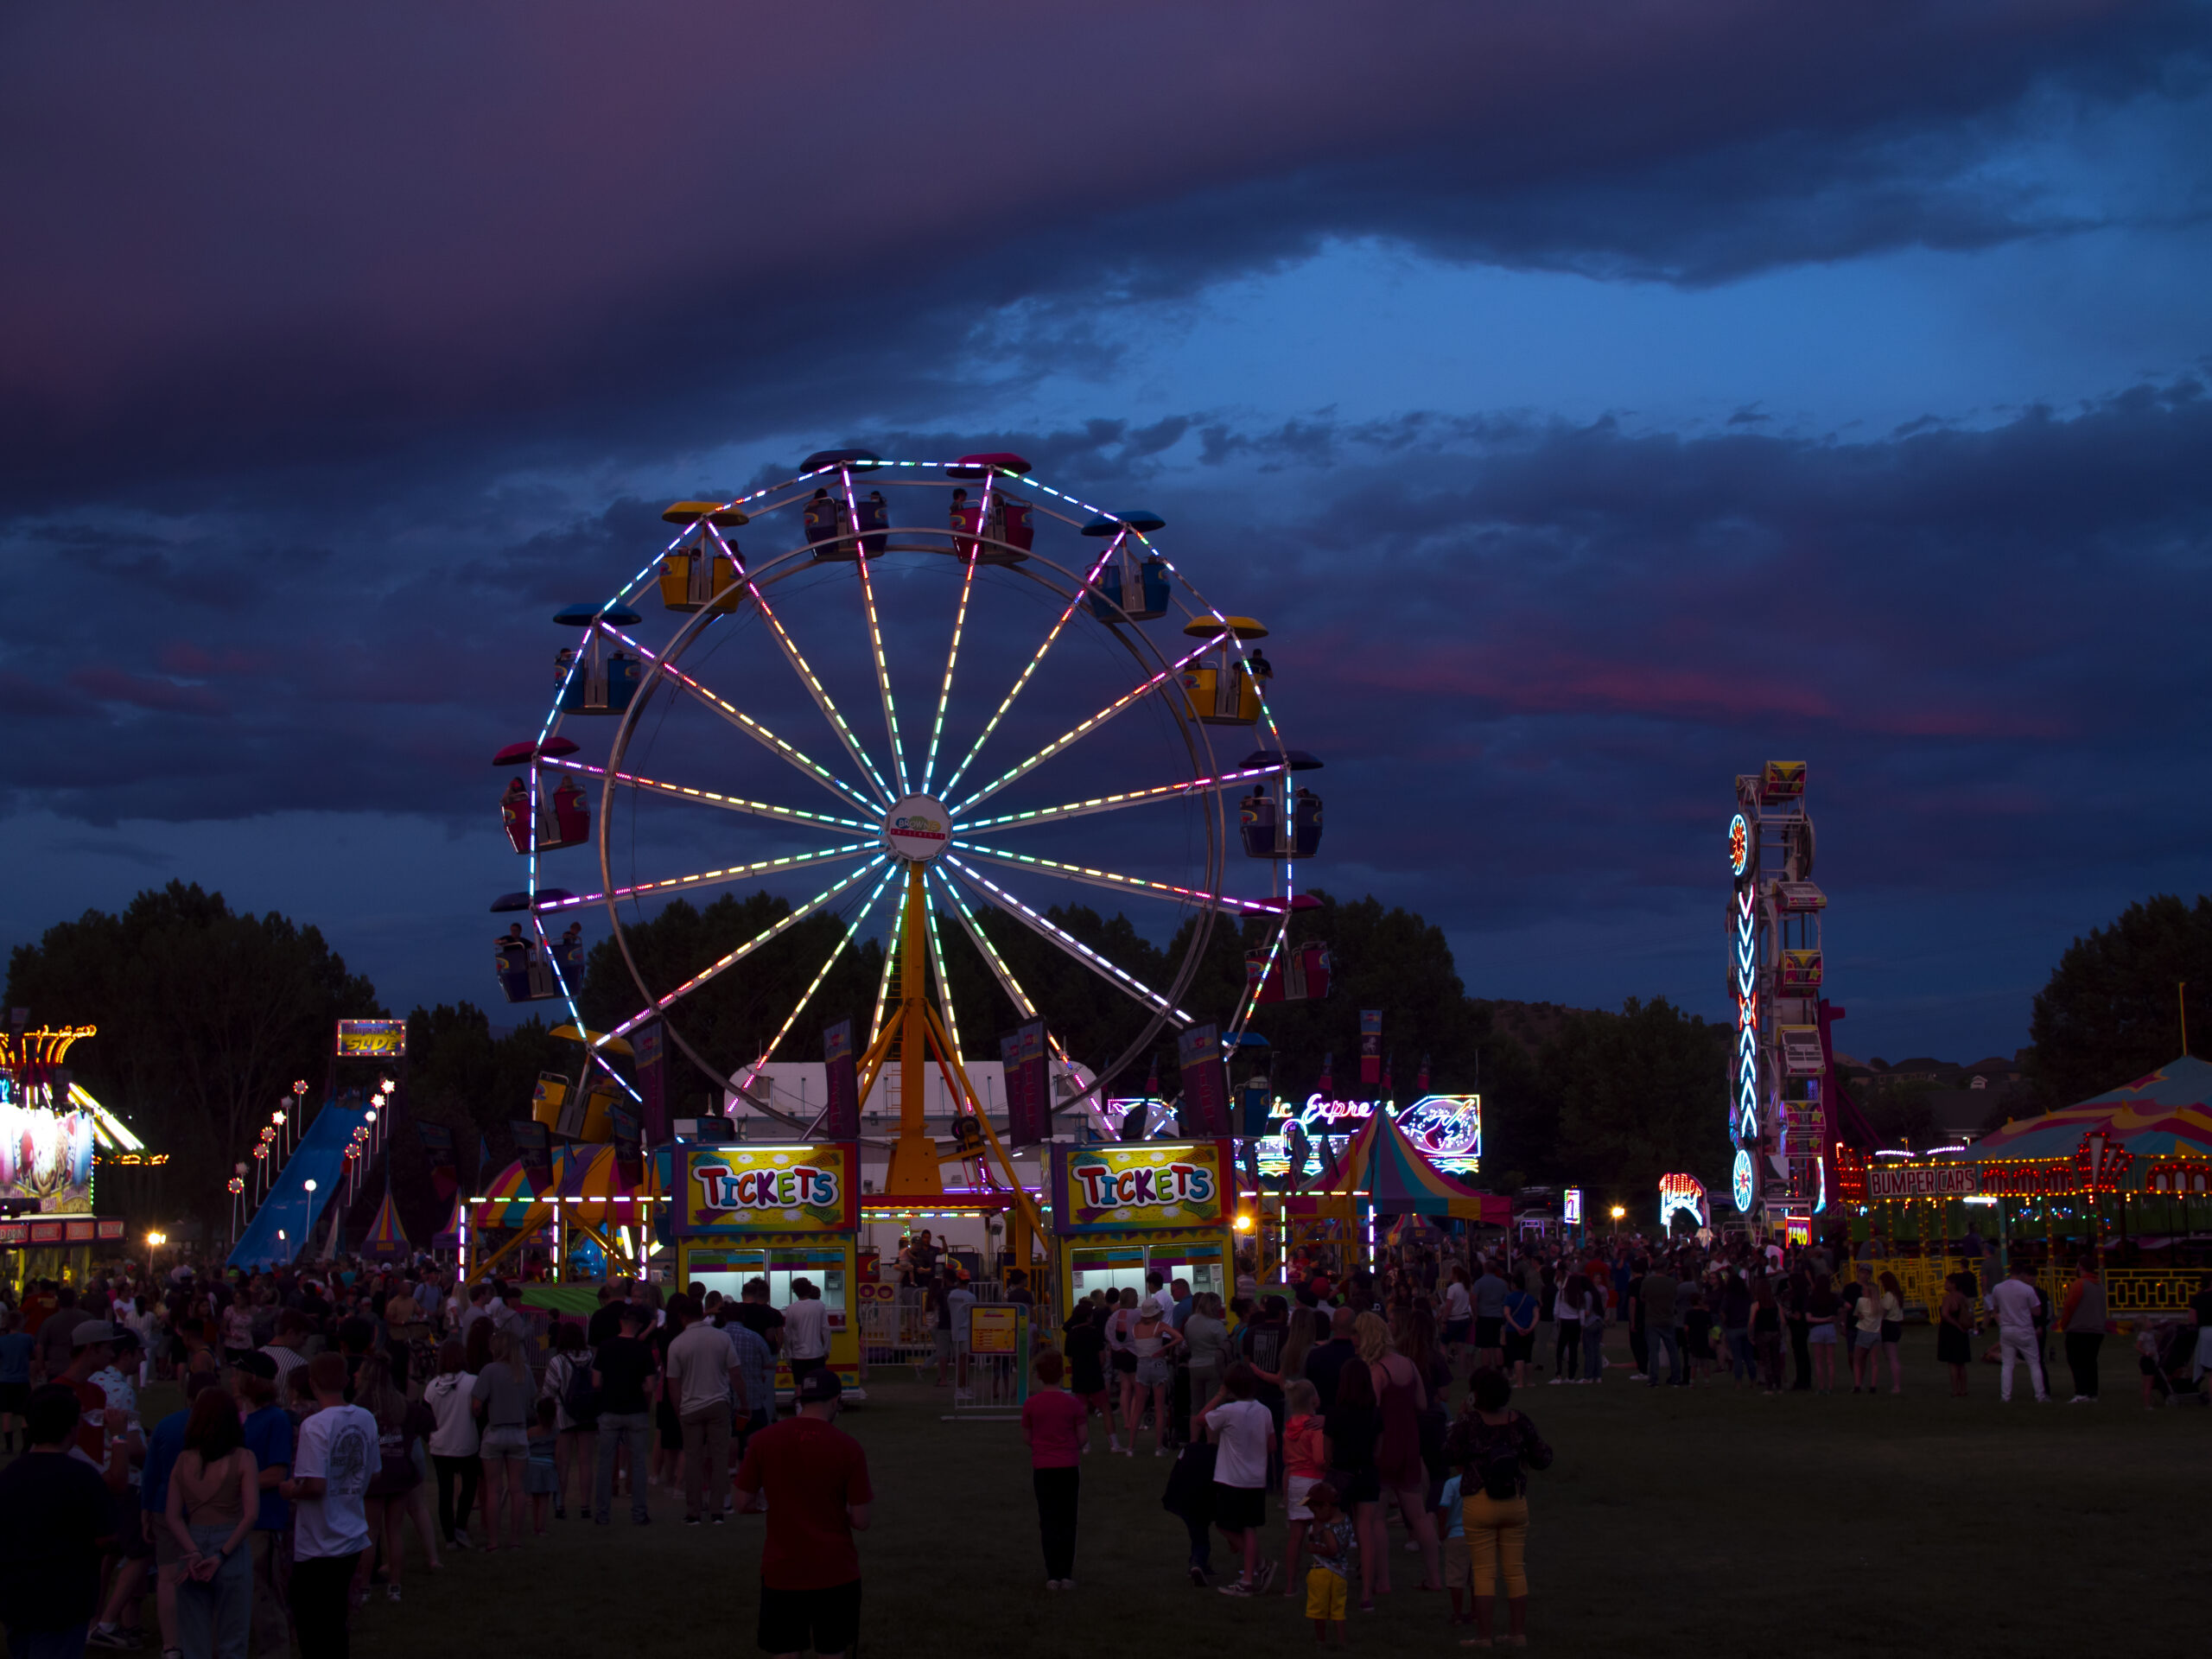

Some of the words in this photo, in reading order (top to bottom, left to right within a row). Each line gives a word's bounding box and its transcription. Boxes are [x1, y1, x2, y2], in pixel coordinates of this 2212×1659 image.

[1300, 1093, 1399, 1125] Expres
[698, 1167, 834, 1206] TICKETS
[1077, 1165, 1209, 1205] TICKETS
[1872, 1171, 1935, 1194] BUMPER
[1938, 1168, 1975, 1192] CARS
[1788, 1227, 1808, 1245] ZERO
